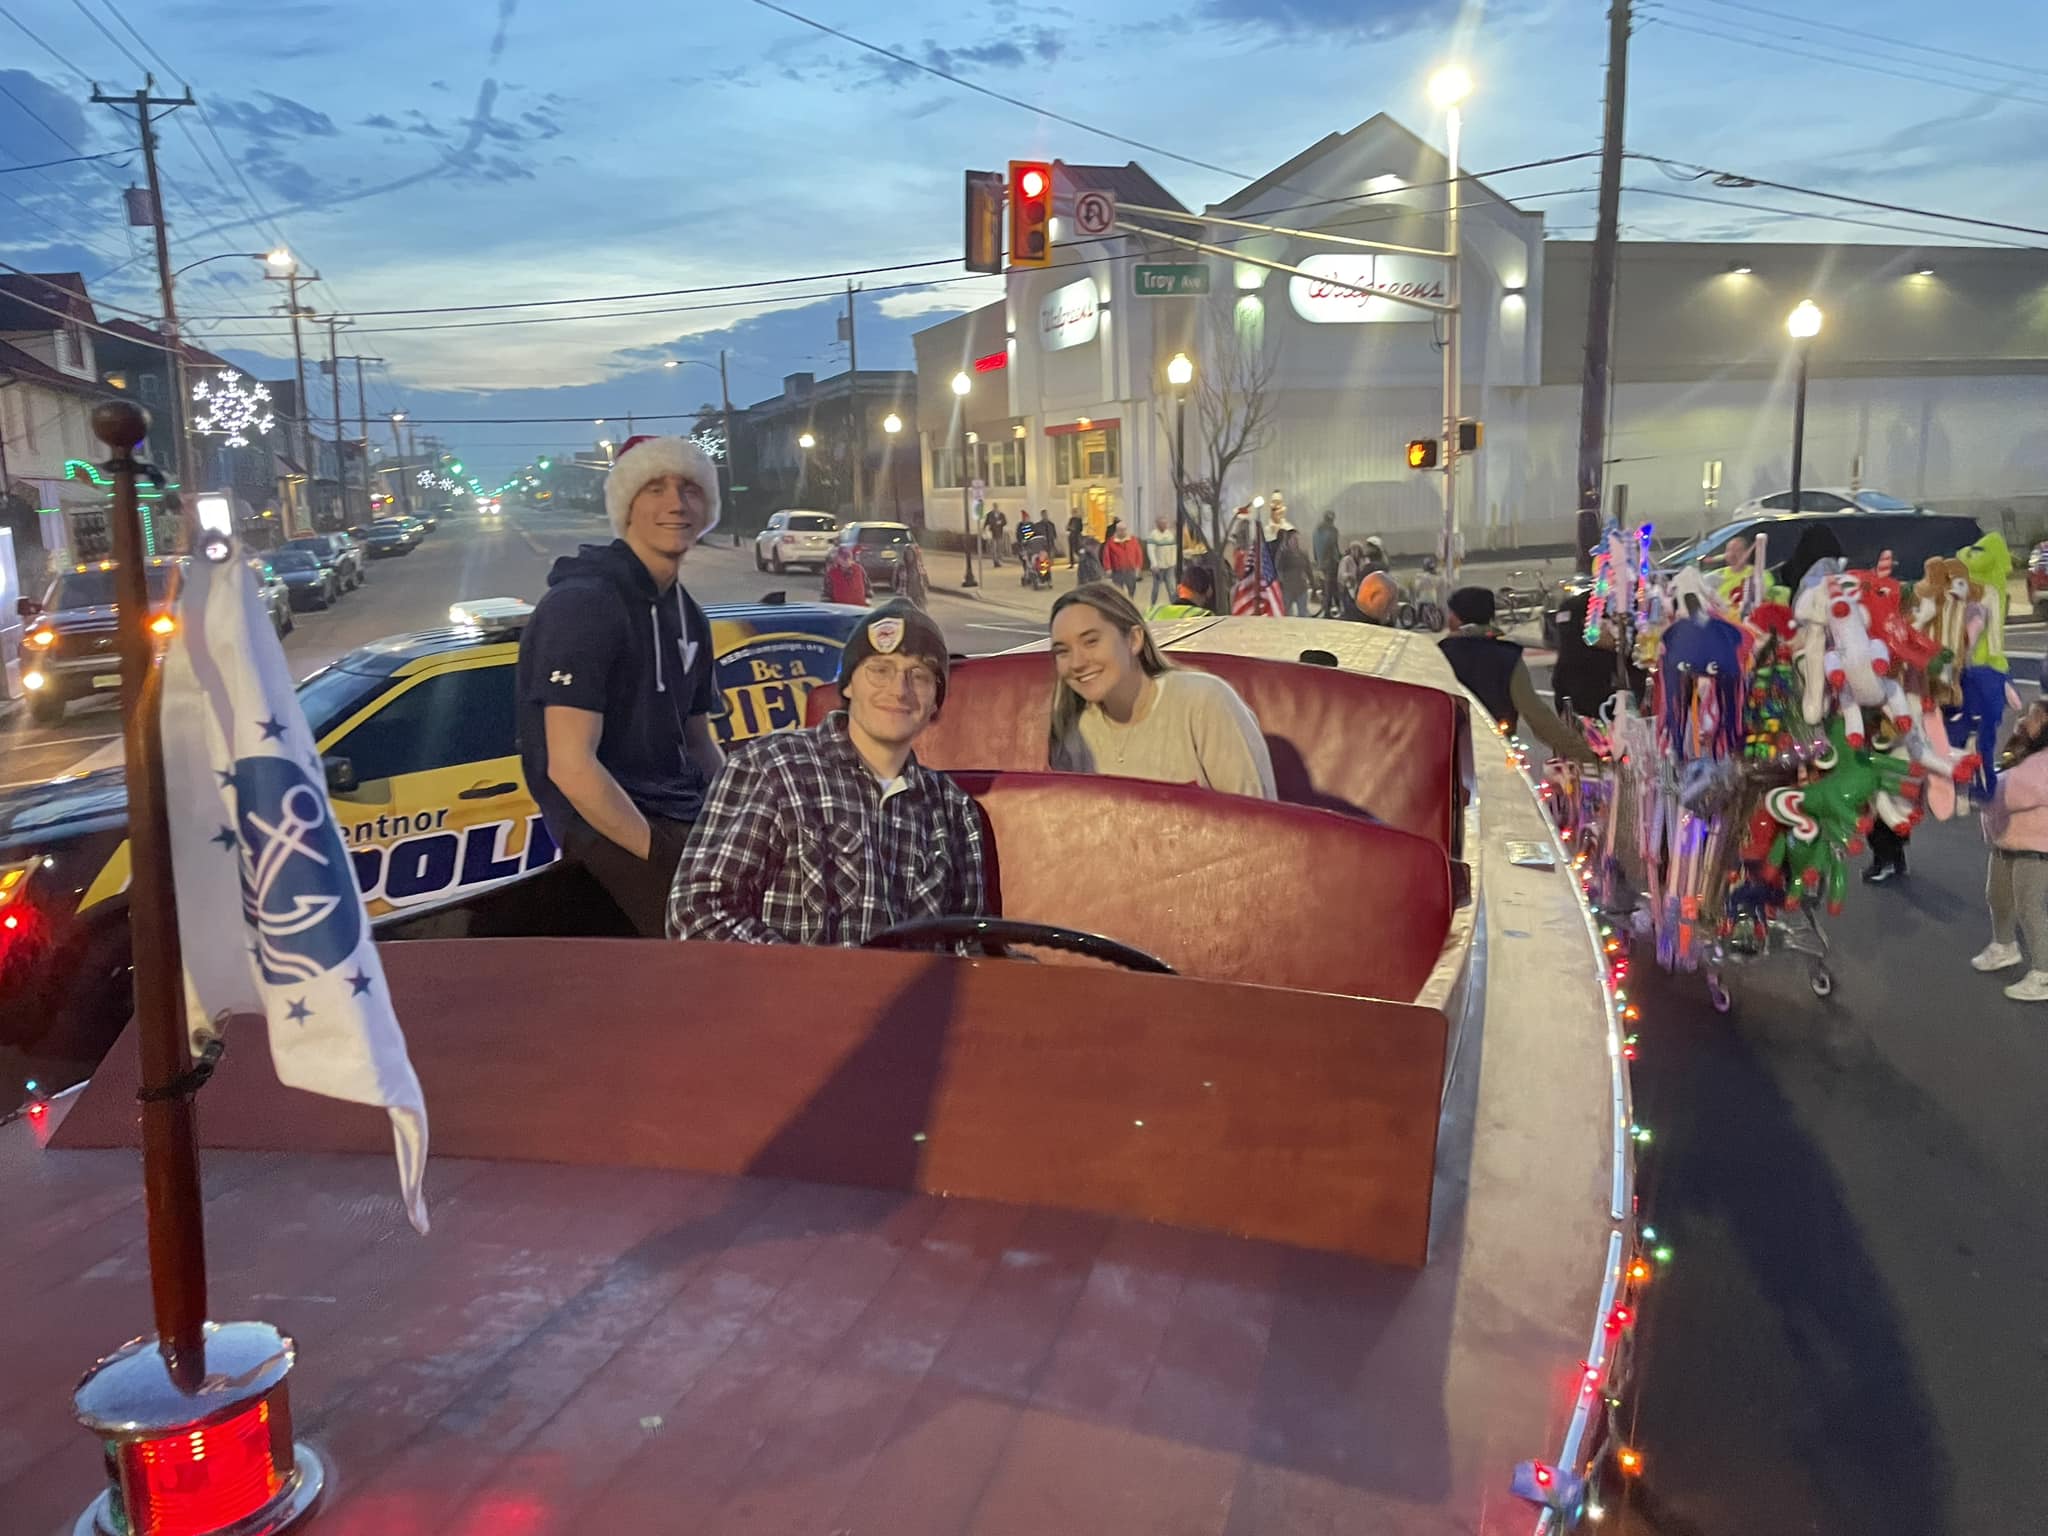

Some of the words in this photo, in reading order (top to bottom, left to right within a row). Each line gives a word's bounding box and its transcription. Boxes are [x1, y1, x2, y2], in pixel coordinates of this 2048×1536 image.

[1142, 271, 1176, 292] Troy
[749, 659, 784, 681] Be
[789, 660, 806, 677] a
[340, 808, 449, 843] entnor
